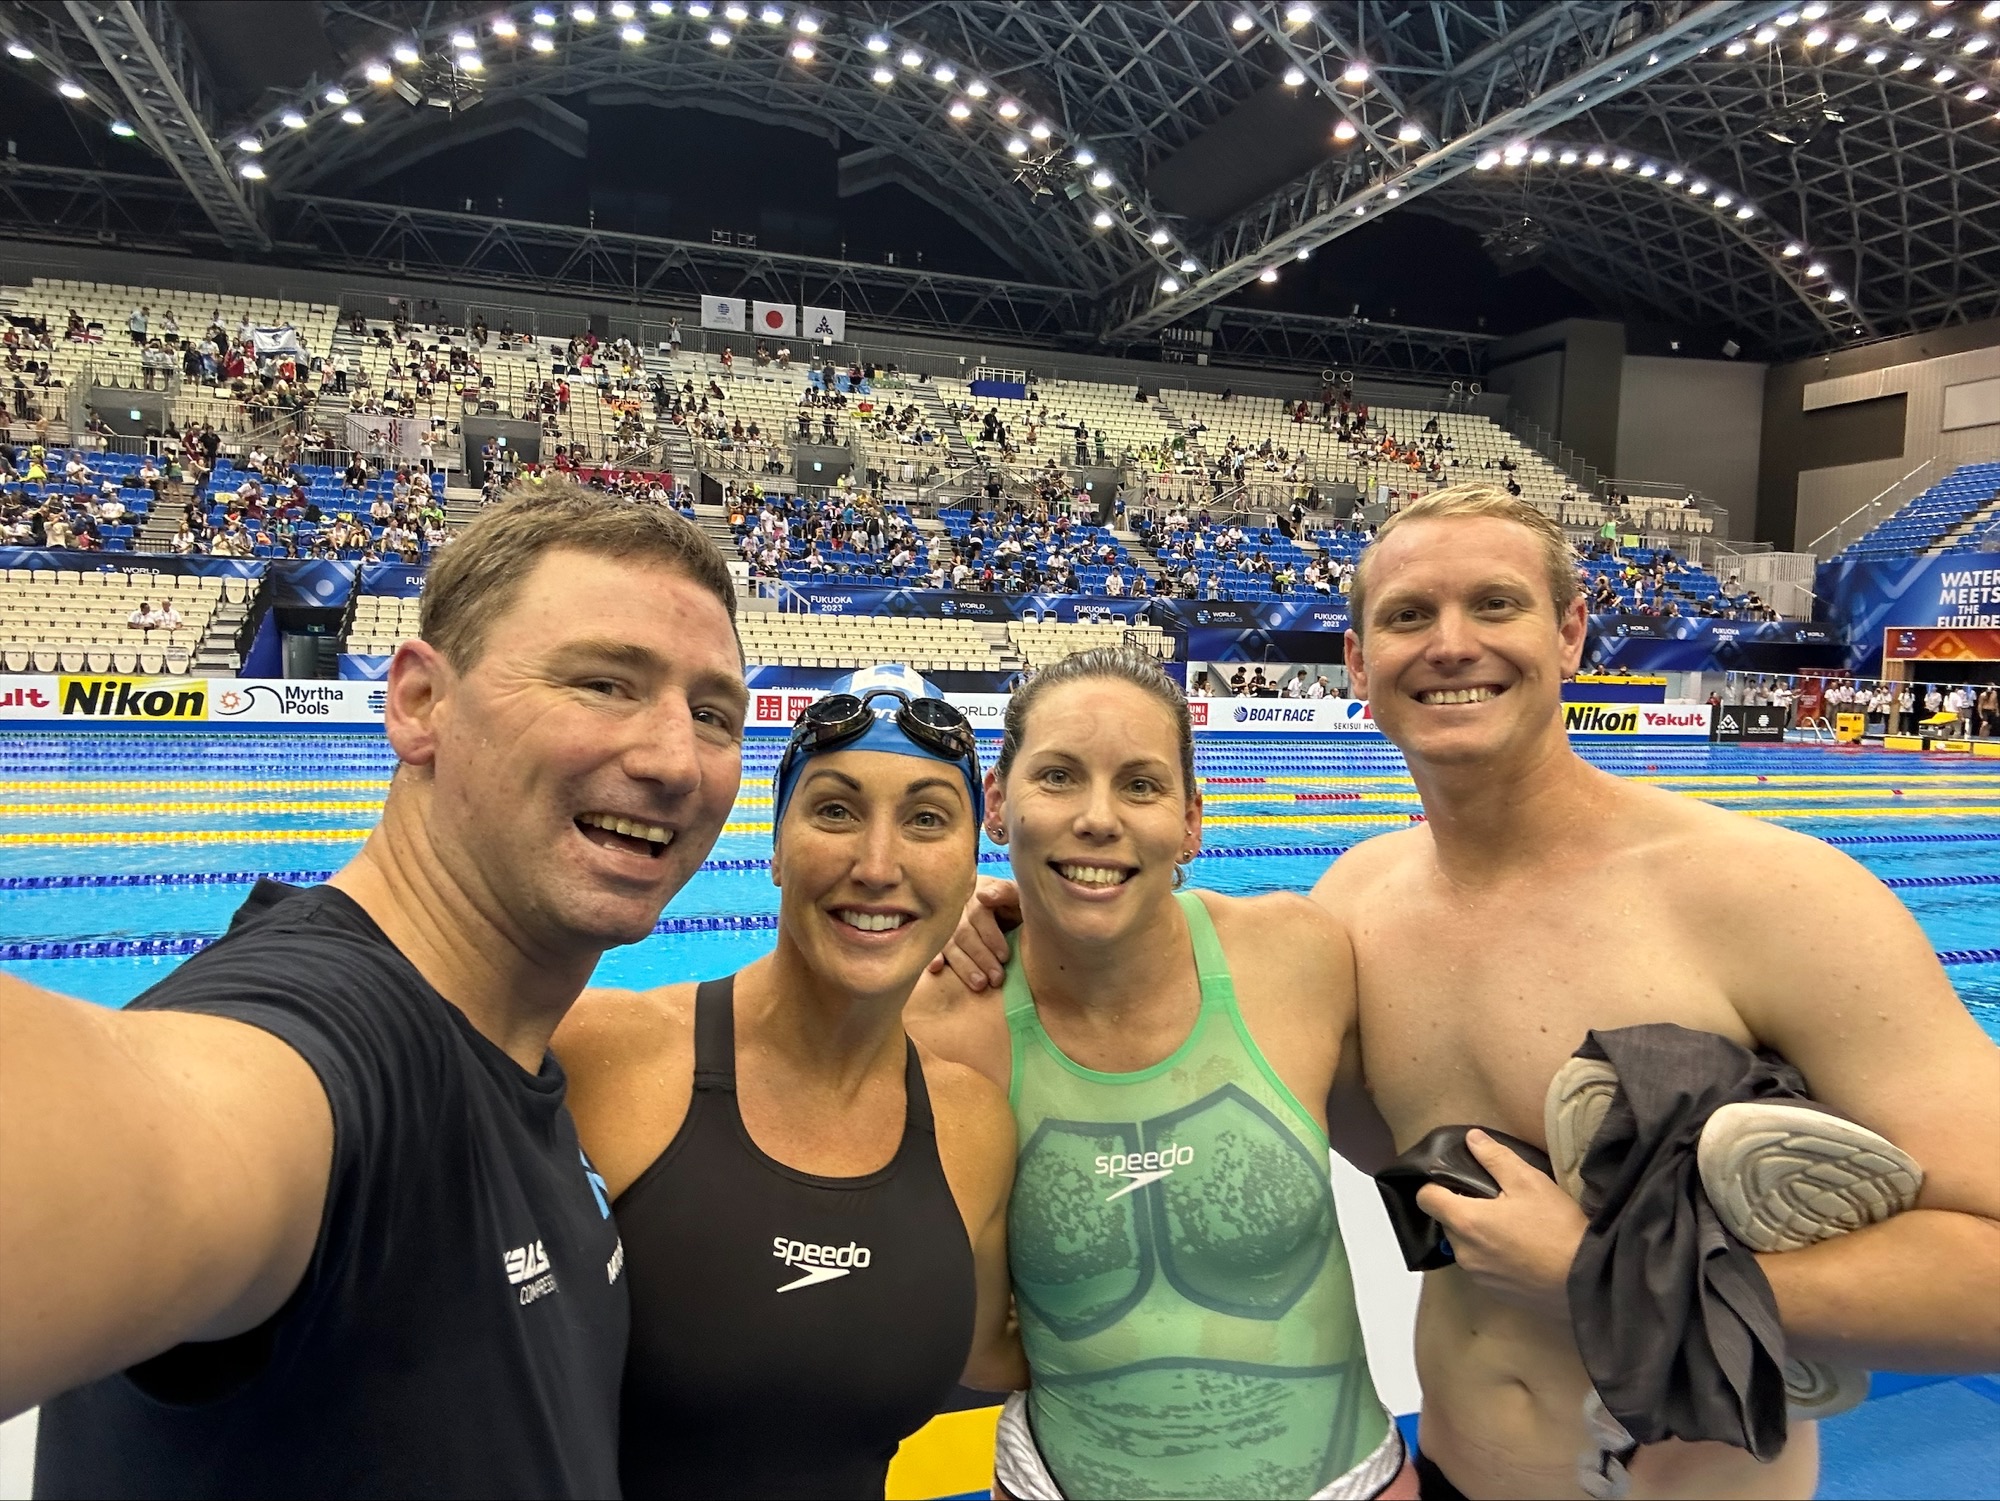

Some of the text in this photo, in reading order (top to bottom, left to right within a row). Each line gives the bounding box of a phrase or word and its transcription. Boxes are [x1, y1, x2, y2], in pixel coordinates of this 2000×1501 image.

[122, 566, 160, 575] WORLD
[1940, 570, 2000, 588] WATER
[810, 595, 853, 605] FUKUOKA
[1939, 587, 2000, 606] MEETS
[821, 604, 843, 612] 2023
[959, 602, 986, 610] WORLD
[1073, 605, 1111, 614] FUKUOKA
[1958, 604, 1979, 615] THE
[959, 608, 994, 616] AQUATICS
[1314, 612, 1348, 621] FUKUOKA
[1322, 620, 1340, 628] 2023
[1937, 615, 2000, 627] FUTURE
[62, 681, 205, 717] Nikon
[285, 686, 343, 703] Myrtha
[285, 700, 329, 715] Pools
[957, 705, 998, 716] ORLD
[1249, 708, 1316, 722] BOAT RACE
[1565, 706, 1637, 732] Nikon
[1643, 712, 1706, 727] Yakult
[1333, 722, 1361, 730] SEKISUI
[1094, 1142, 1194, 1179] speedo
[773, 1236, 871, 1268] speedo
